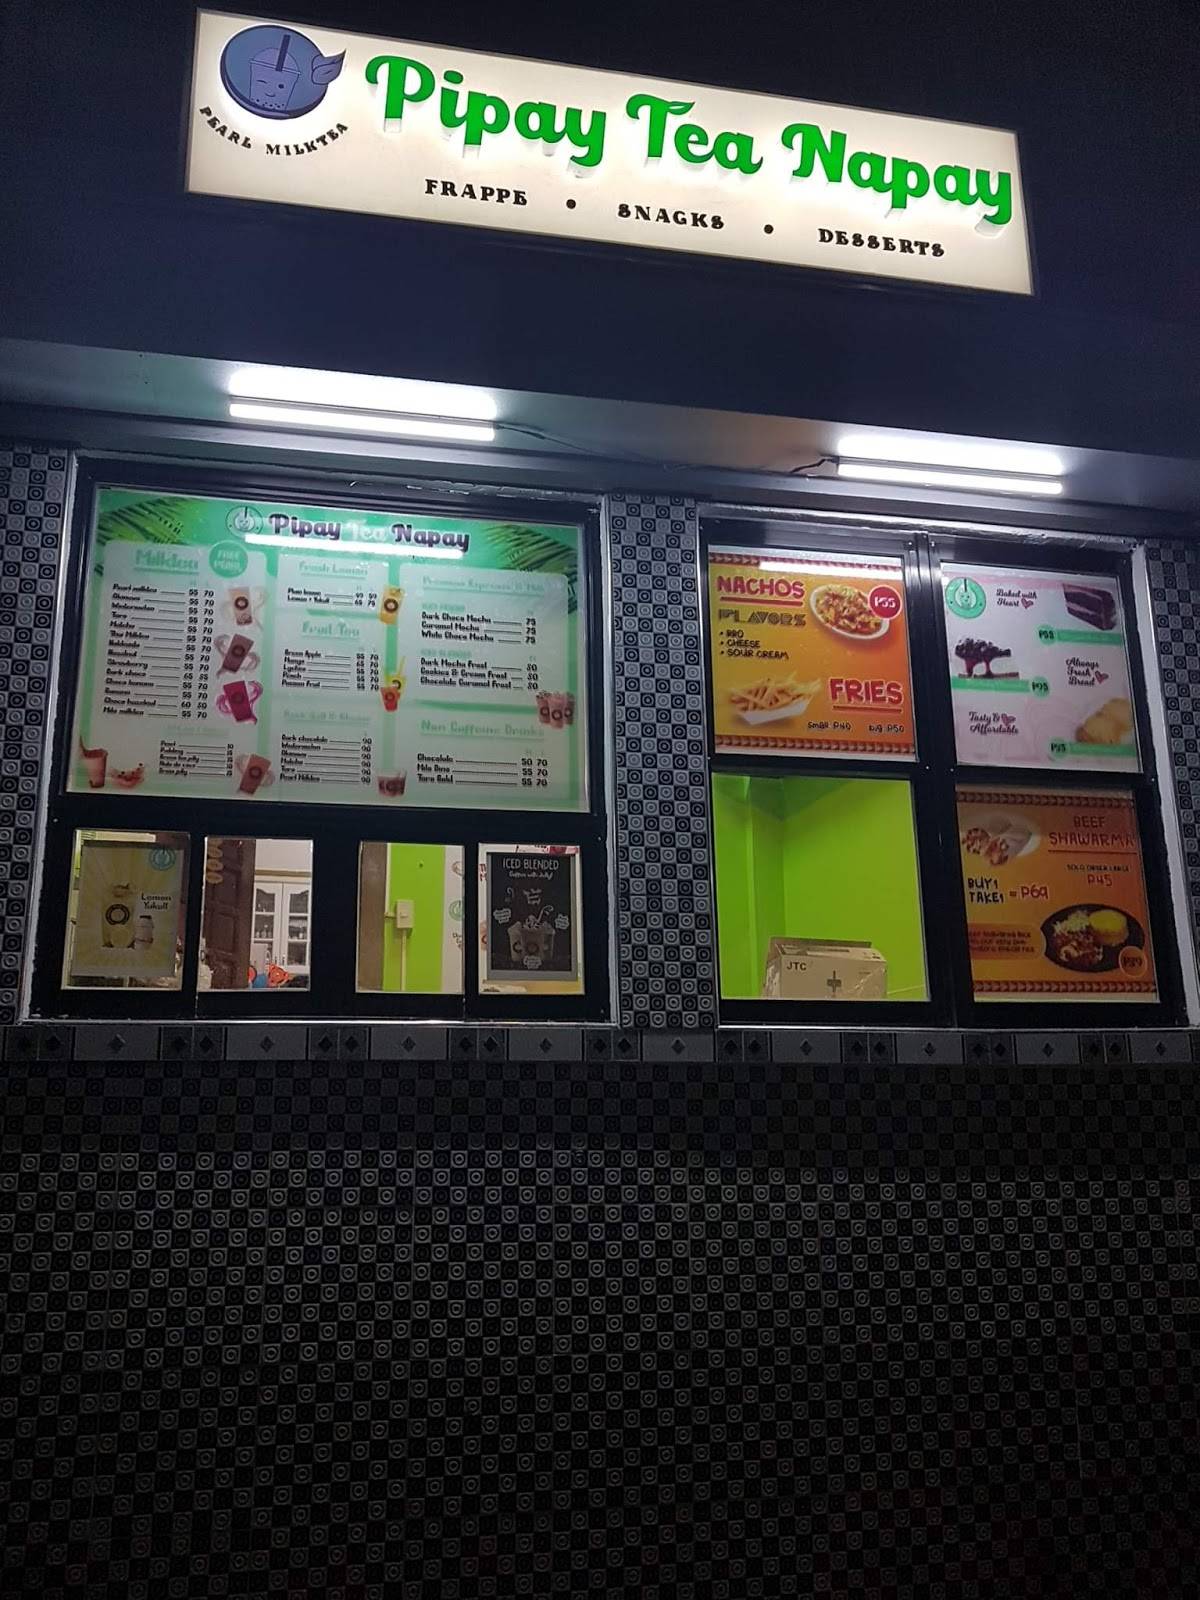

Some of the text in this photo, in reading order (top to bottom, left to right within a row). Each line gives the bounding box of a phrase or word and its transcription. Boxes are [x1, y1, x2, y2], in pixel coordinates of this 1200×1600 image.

[199, 106, 349, 157] PEARL MILKTEA
[364, 54, 1012, 226] Pipay Tea Napay
[818, 228, 945, 258] DESSERTS
[269, 512, 341, 541] Pipay
[391, 523, 470, 553] Napay
[716, 575, 805, 600] NACHOS
[996, 588, 1038, 600] Baked with
[996, 598, 1020, 607] Heart
[526, 618, 536, 626] 75
[718, 608, 807, 627] FLAVORS
[526, 627, 536, 636] 75
[526, 636, 536, 644] 75
[726, 639, 761, 649] CHEESE
[727, 648, 790, 660] SOUR CREAM
[1065, 657, 1100, 669] Always
[1066, 668, 1092, 677] Fresh
[1068, 676, 1096, 687] Bread
[829, 678, 904, 706] FRIES
[969, 711, 1000, 724] Tasty &
[969, 724, 1019, 735] Affordable
[536, 758, 548, 766] 70
[522, 768, 533, 776] 55
[521, 778, 532, 786] 55
[536, 778, 548, 786] 70
[1073, 815, 1105, 829] BEEF
[1048, 831, 1136, 849] SHAWARMA
[503, 857, 559, 871] ICED BLENDED
[1087, 874, 1112, 887] P45
[786, 961, 807, 971] JTC
